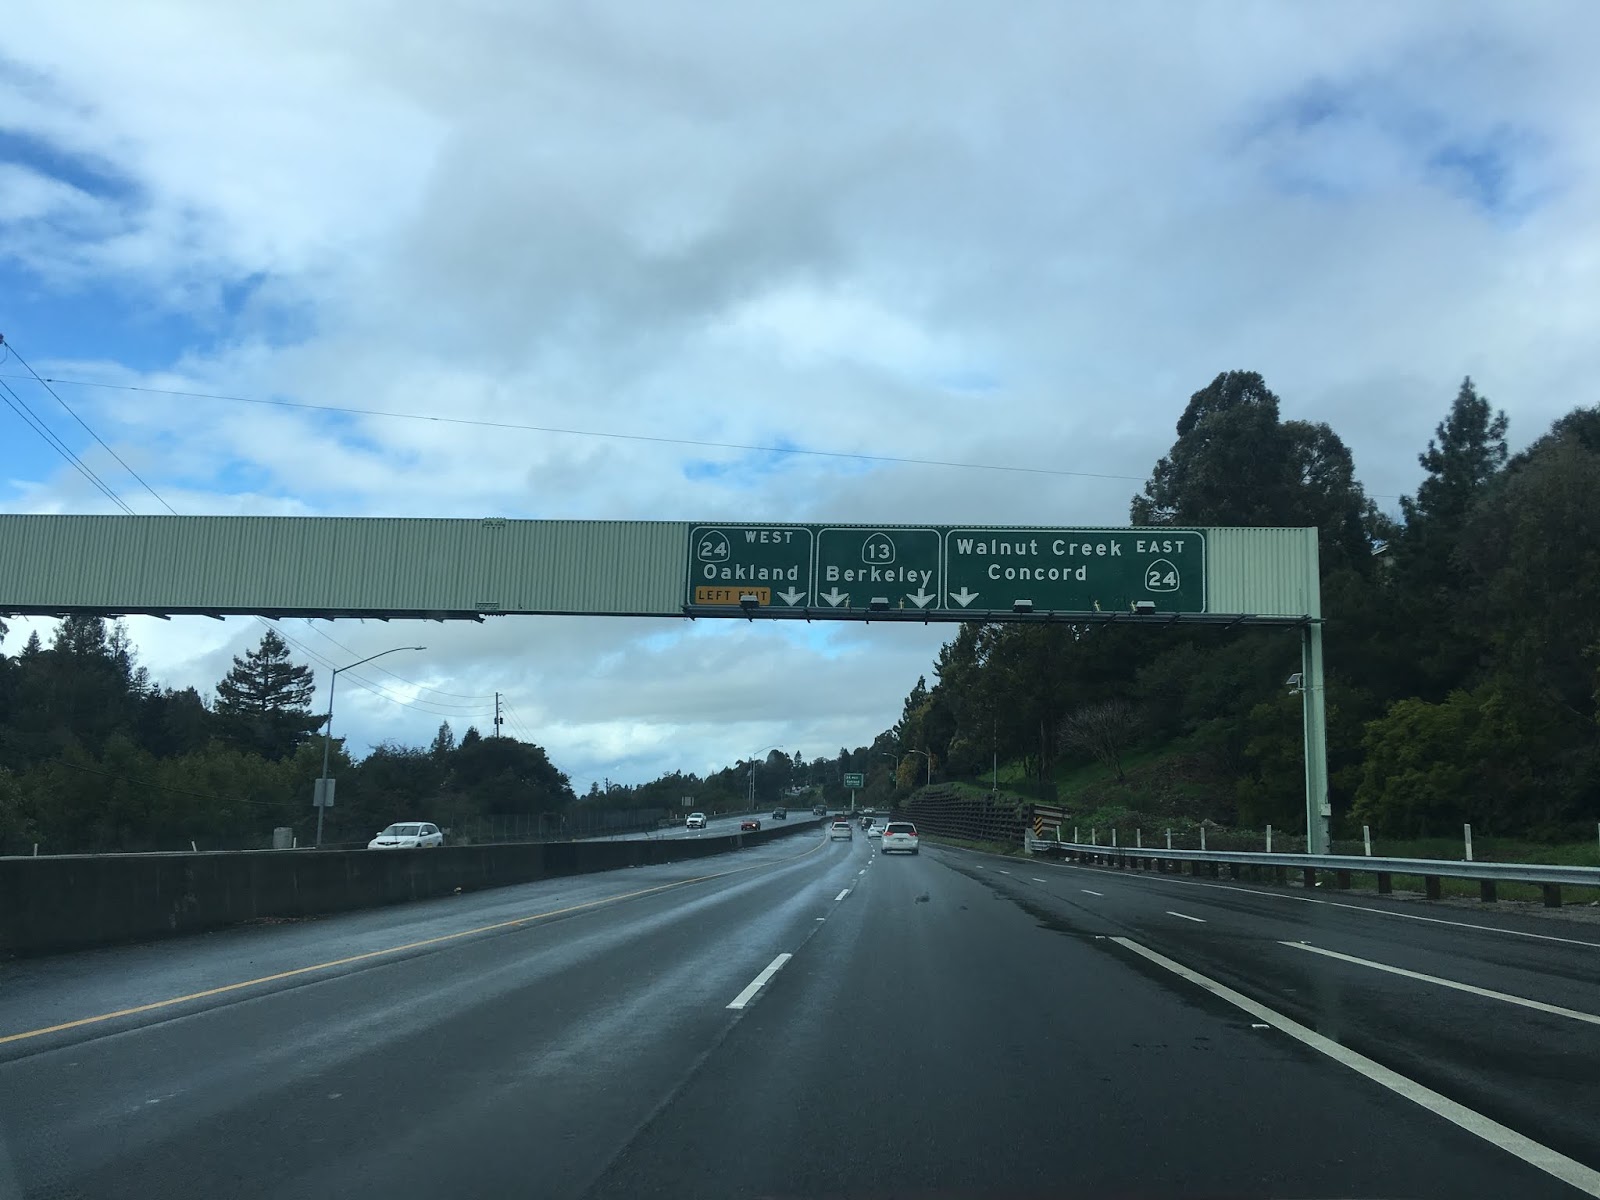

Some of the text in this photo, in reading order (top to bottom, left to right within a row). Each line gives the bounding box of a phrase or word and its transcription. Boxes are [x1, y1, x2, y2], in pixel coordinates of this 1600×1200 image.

[745, 531, 794, 544] WEST
[701, 542, 727, 556] 24
[868, 544, 890, 559] 13
[957, 539, 1122, 556] Walnut Creek
[1137, 540, 1185, 553] EAST
[703, 564, 798, 580] Oakland
[826, 565, 932, 588] Berkeley
[988, 564, 1087, 580] Concord
[1148, 571, 1176, 586] 24
[698, 590, 731, 600] LEFT
